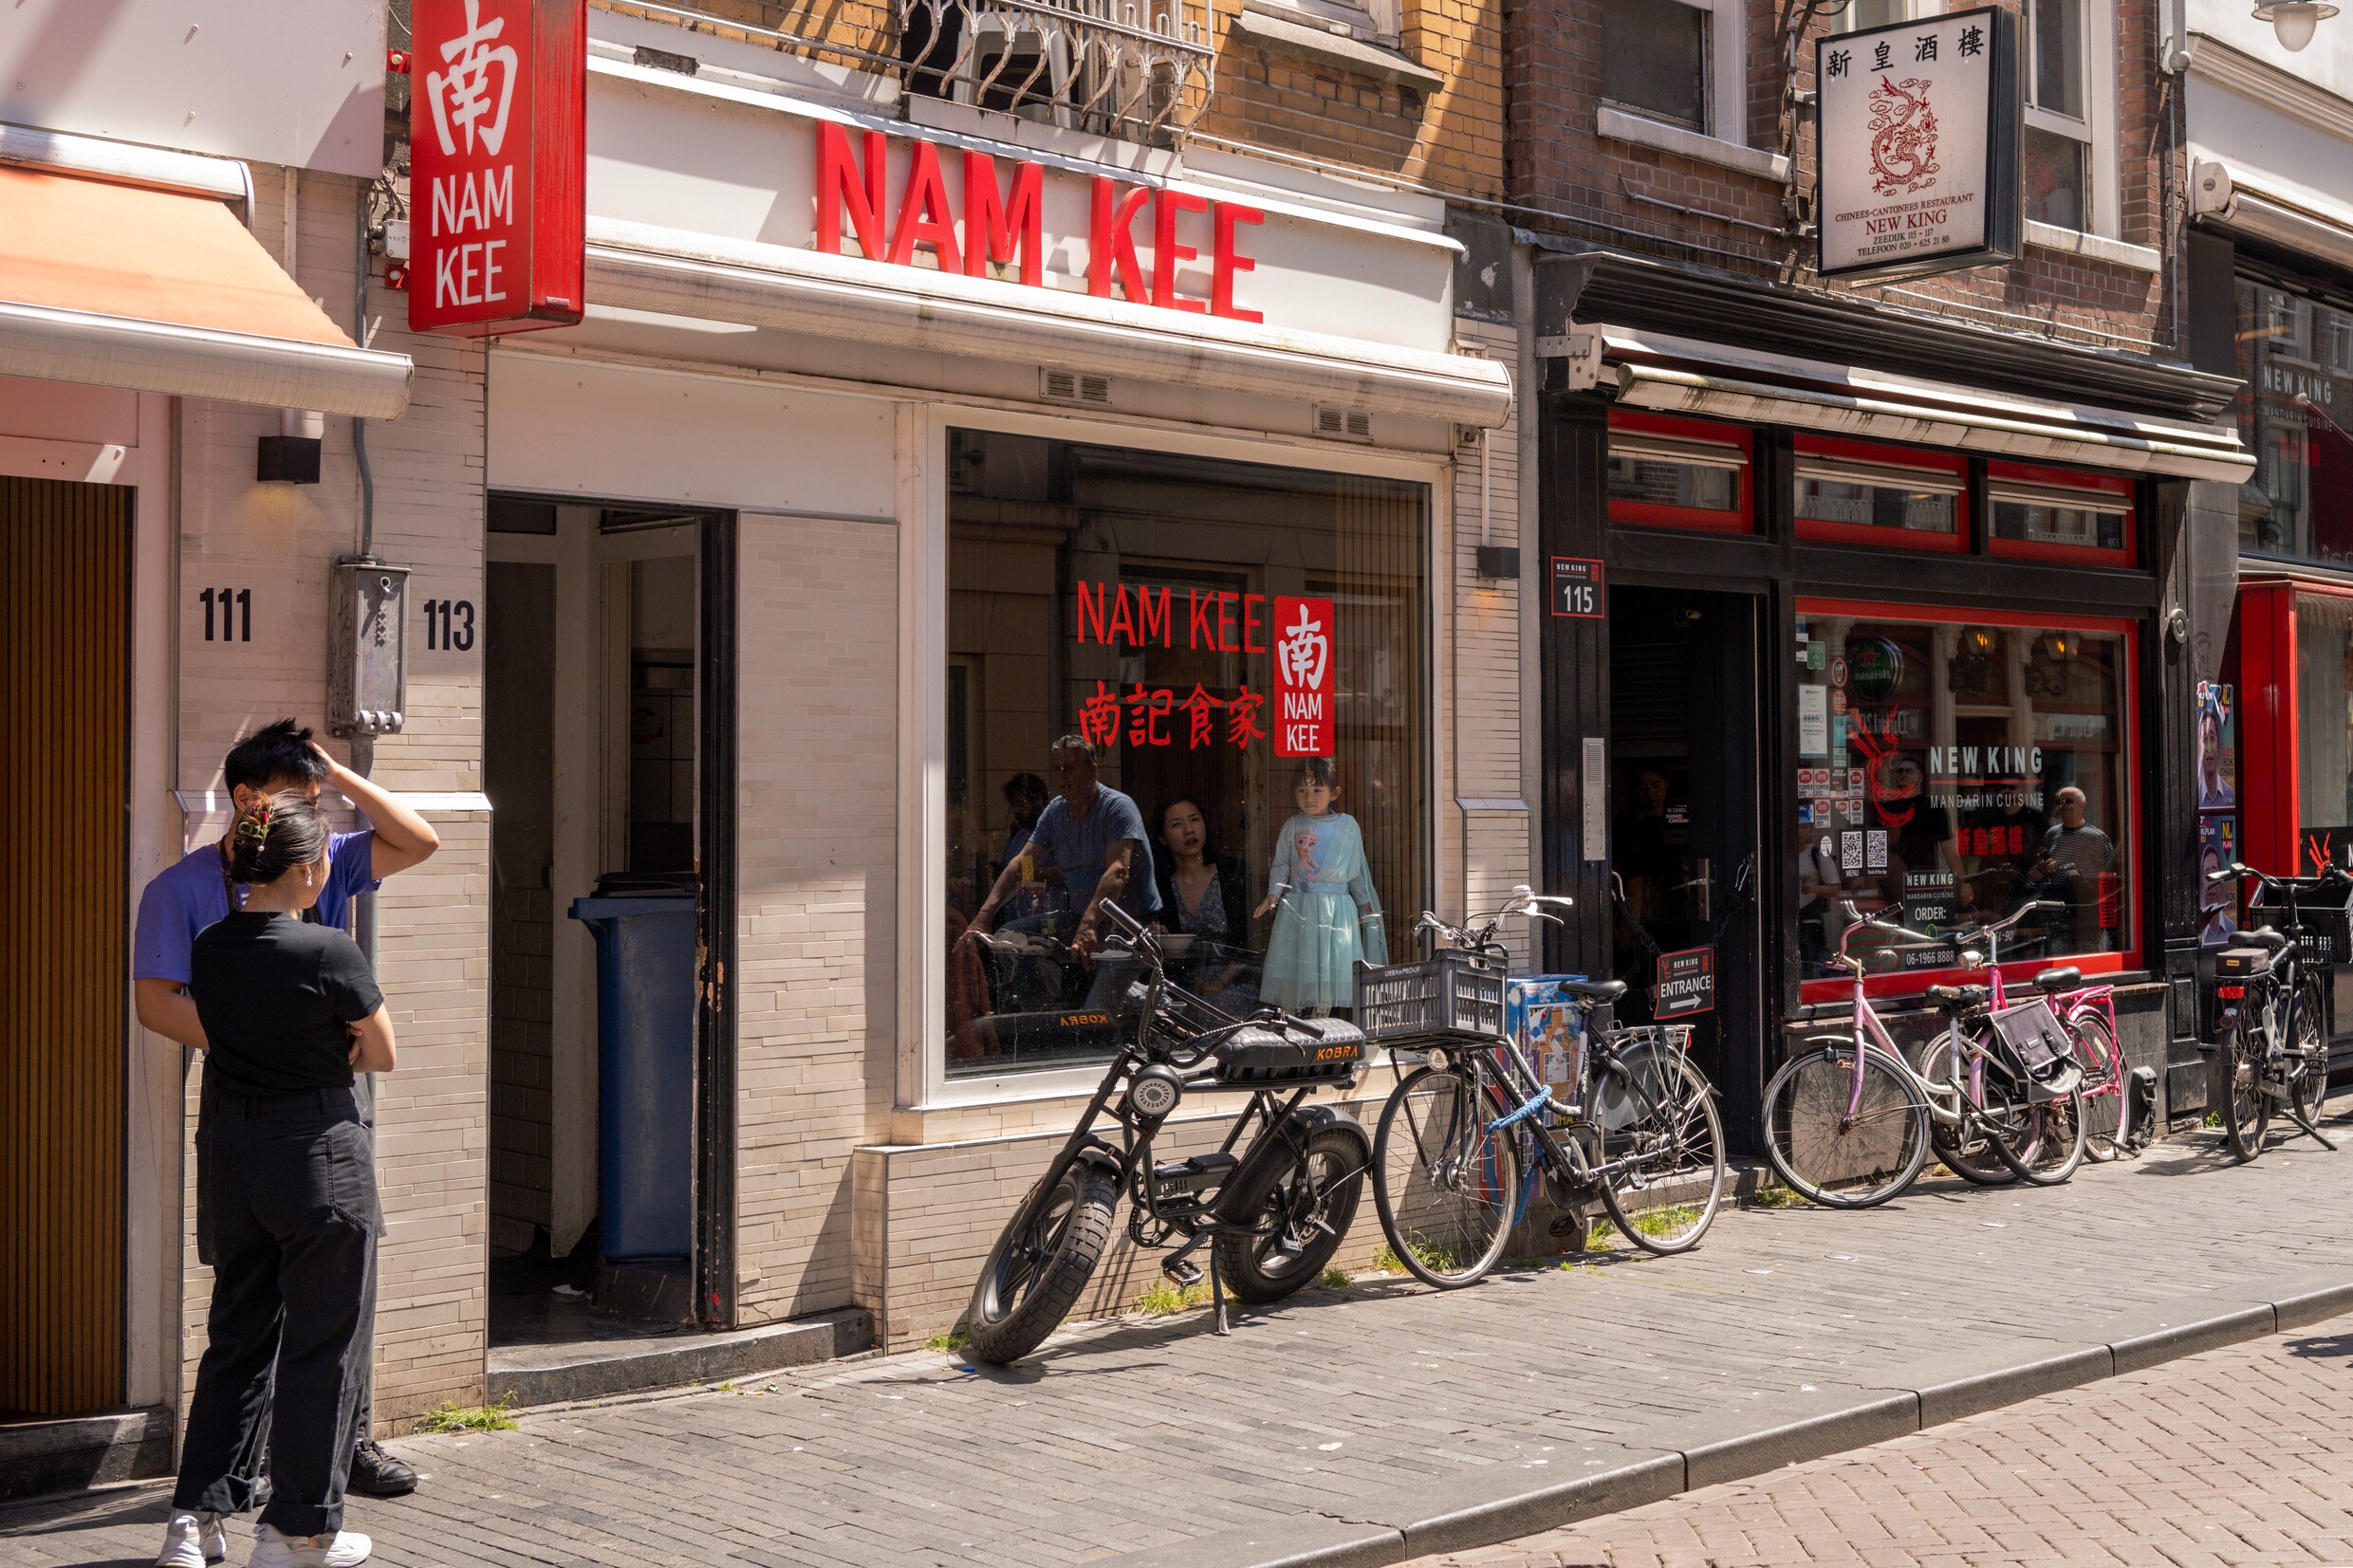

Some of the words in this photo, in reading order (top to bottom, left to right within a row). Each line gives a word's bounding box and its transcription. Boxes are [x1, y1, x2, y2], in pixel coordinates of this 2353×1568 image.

[1827, 26, 1984, 79] 新皇酒樓
[426, 0, 518, 156] 南
[432, 164, 513, 237] NAM
[1835, 202, 1918, 222] CHINEES-CANTONEES
[1920, 193, 1973, 210] RESTAURANT
[817, 119, 1043, 287] NAM
[1089, 175, 1265, 324] KEE
[1865, 215, 1901, 235] NEW
[1906, 209, 1948, 230] KING
[1908, 231, 1918, 240] 115
[1924, 229, 1934, 237] 117
[1858, 243, 1898, 257] TELEFOON
[1899, 241, 1912, 250] 020
[1919, 238, 1931, 248] 625
[1934, 236, 1939, 246] 21
[1941, 235, 1950, 244] 80
[435, 239, 507, 308] KEE
[2264, 364, 2293, 395] NEW
[2298, 375, 2332, 404] KING
[2264, 405, 2303, 425] MANDARIN
[2304, 415, 2334, 433] CUISINE
[1570, 564, 1586, 573] KING
[1564, 585, 1593, 613] 115
[199, 587, 250, 642] 111
[424, 600, 474, 652] 113
[1078, 581, 1171, 649] NAM
[1190, 589, 1266, 655] KEE
[1278, 603, 1328, 691] 南
[1078, 680, 1267, 751] 南記食家
[1284, 692, 1323, 720] NAM
[1287, 724, 1320, 752] KEE
[1930, 746, 1978, 774] NEW
[1988, 746, 2043, 774] KING
[1930, 795, 1993, 808] MANDARIN
[1996, 793, 2045, 807] CUISINE
[2200, 835, 2207, 843] EU
[2222, 821, 2233, 840] NL
[2222, 840, 2233, 849] PLAN
[1845, 869, 1860, 877] MENU
[1906, 874, 1927, 887] NEW
[1930, 873, 1954, 886] KING
[1915, 906, 1947, 921] ORDER:
[1673, 959, 1685, 968] NEW
[1685, 957, 1698, 967] KING
[1906, 950, 1936, 966] 06-1966
[1937, 950, 1955, 963] 8888
[1660, 975, 1711, 998] ENTRANCE
[1316, 1044, 1358, 1061] KOBRA
